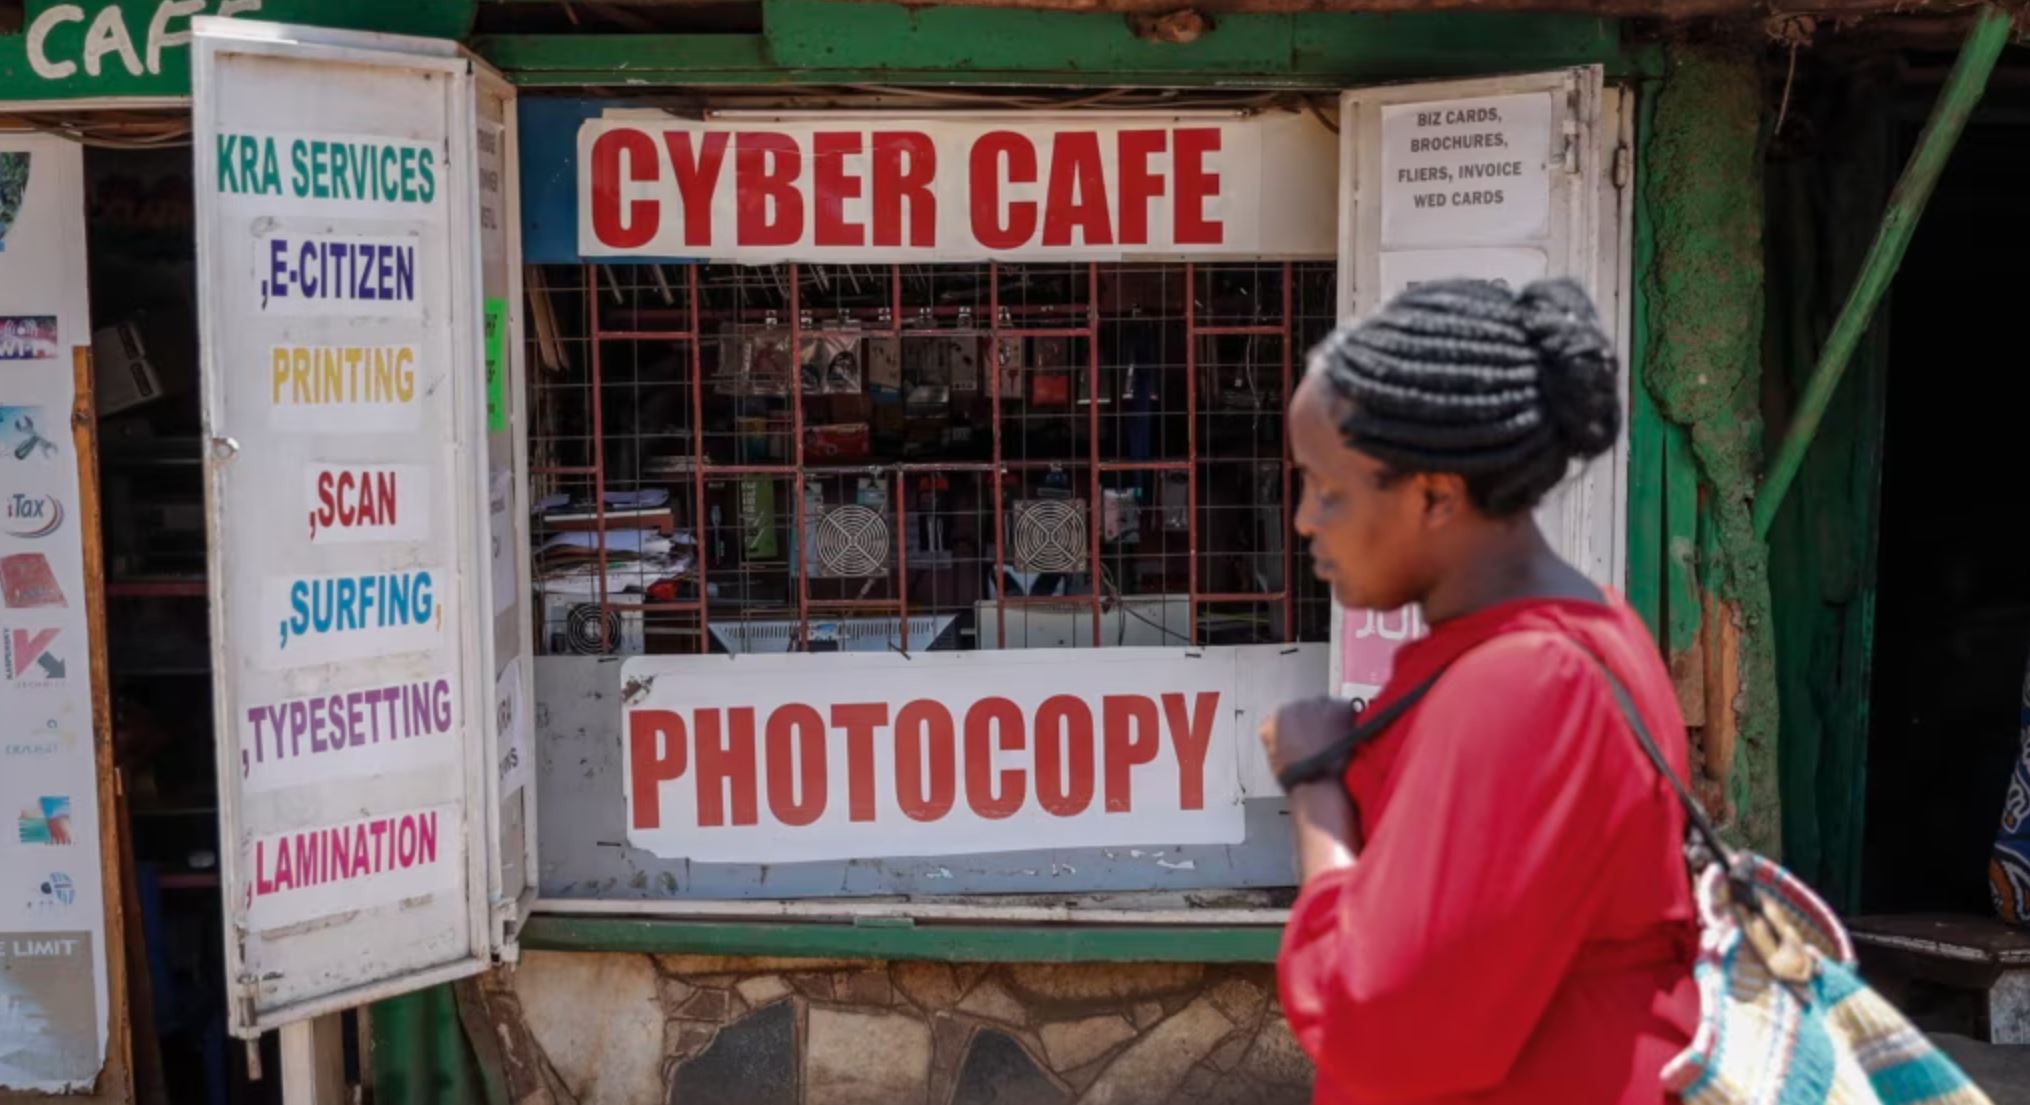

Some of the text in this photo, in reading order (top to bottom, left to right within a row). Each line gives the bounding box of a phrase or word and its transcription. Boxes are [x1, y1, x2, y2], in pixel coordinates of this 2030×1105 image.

[26, 0, 262, 78] CAF
[1417, 107, 1503, 127] BIZ CARDS,
[1410, 133, 1508, 152] BROCHURES,
[216, 133, 283, 196] KRA
[290, 138, 436, 204] SERVICES
[1397, 161, 1522, 184] FLIERS, INVOICE
[591, 127, 1224, 250] CYBER CAFE
[1413, 190, 1504, 209] WED CARDS
[271, 346, 414, 405] PRINTING
[8, 493, 44, 518] iTax
[629, 691, 1221, 830] PHOTOCOPY
[13, 940, 80, 958] LIMIT
